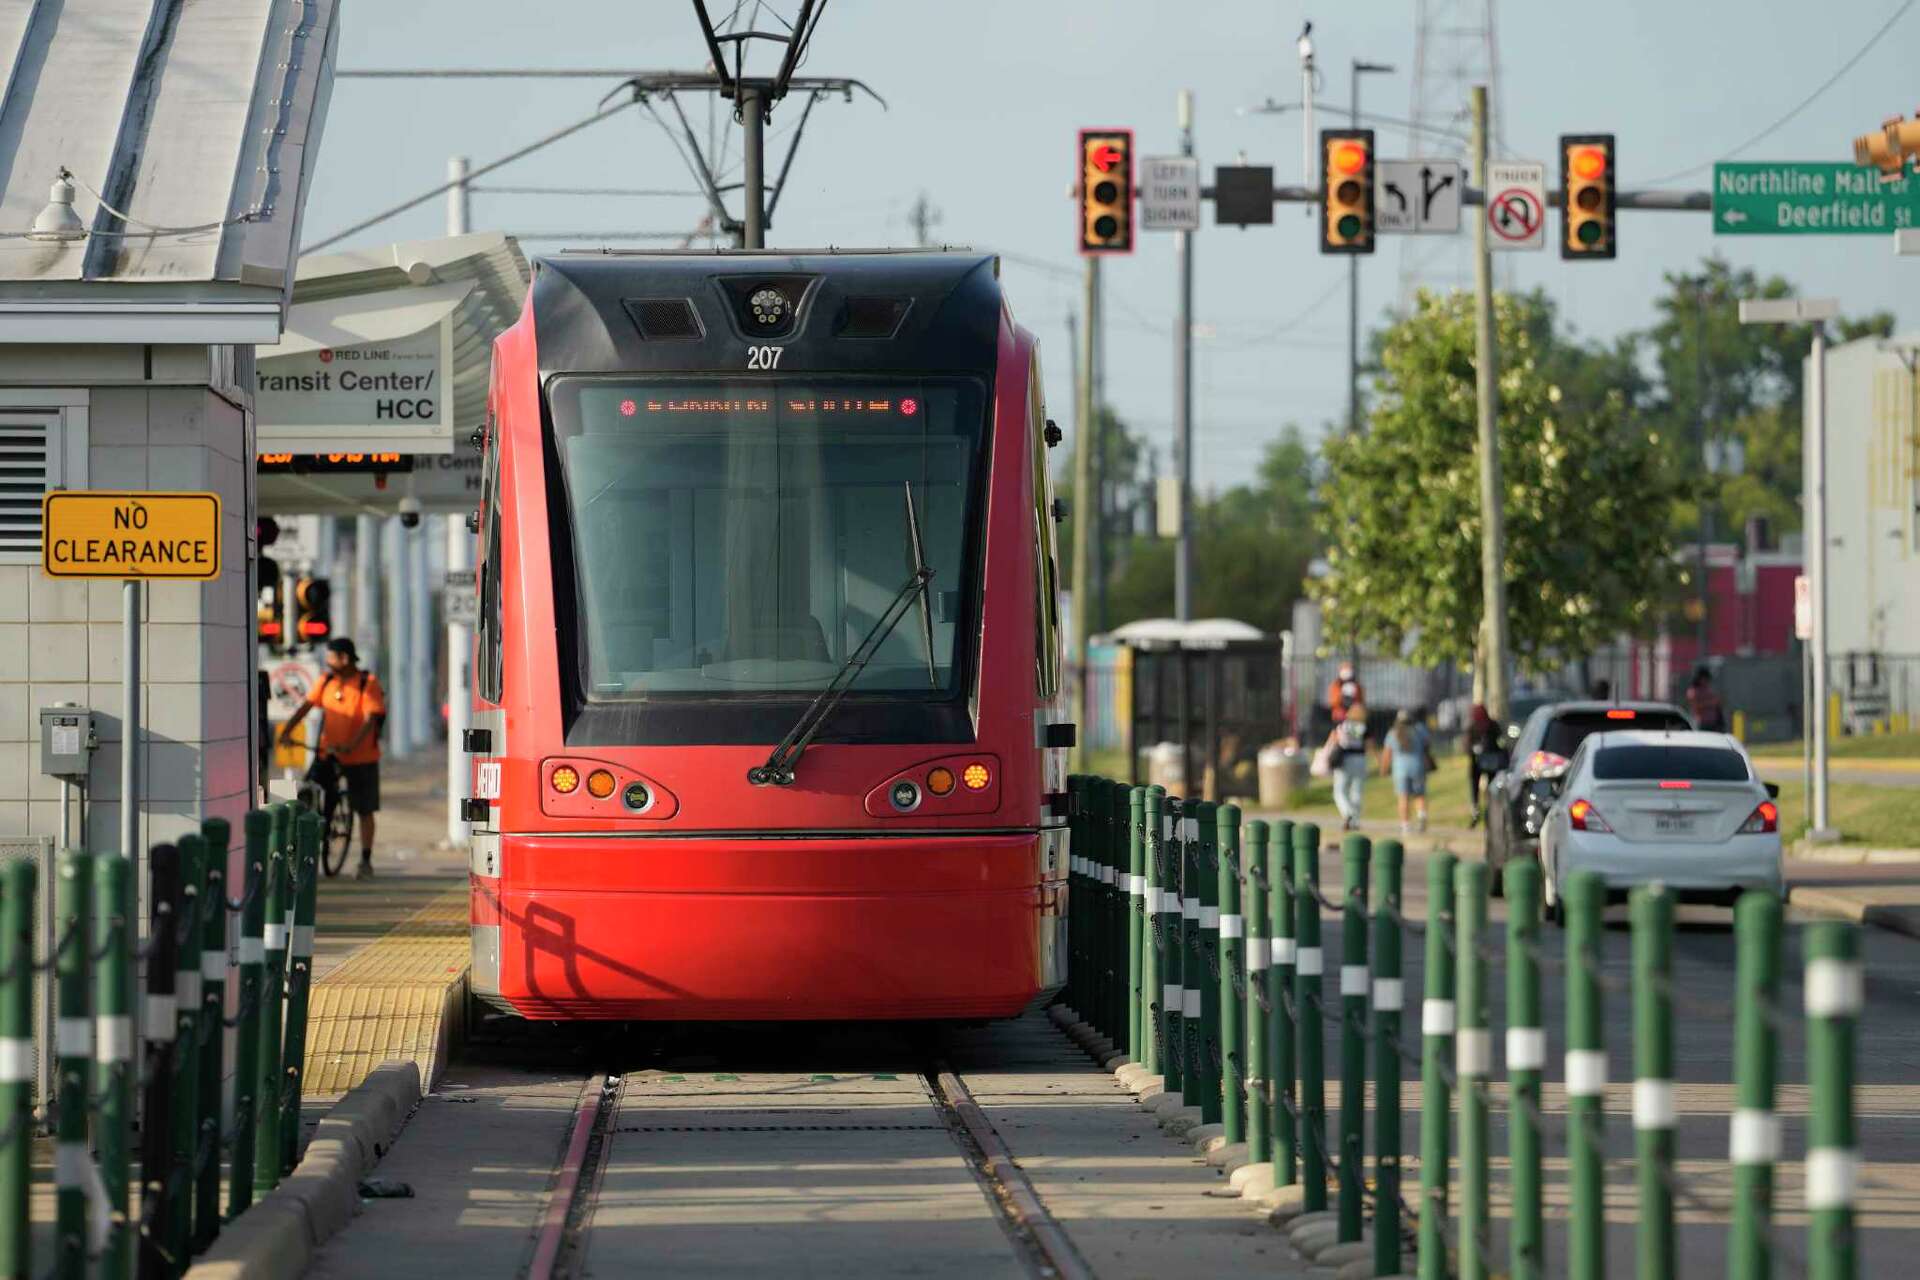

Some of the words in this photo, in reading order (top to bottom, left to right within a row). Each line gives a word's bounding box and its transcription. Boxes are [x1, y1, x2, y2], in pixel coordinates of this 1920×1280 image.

[1154, 185, 1188, 199] TURN
[1720, 170, 1824, 194] Northline
[1835, 170, 1881, 194] Mall
[1144, 207, 1194, 222] SIGNAL
[1777, 202, 1885, 227] Deerfield
[335, 350, 360, 361] RED
[363, 350, 390, 361] LINE
[747, 345, 784, 370] 207
[256, 370, 331, 391] ransit
[339, 370, 434, 391] Center/
[376, 399, 434, 419] HCC
[114, 506, 148, 529] NO
[54, 539, 208, 563] CLEARANCE
